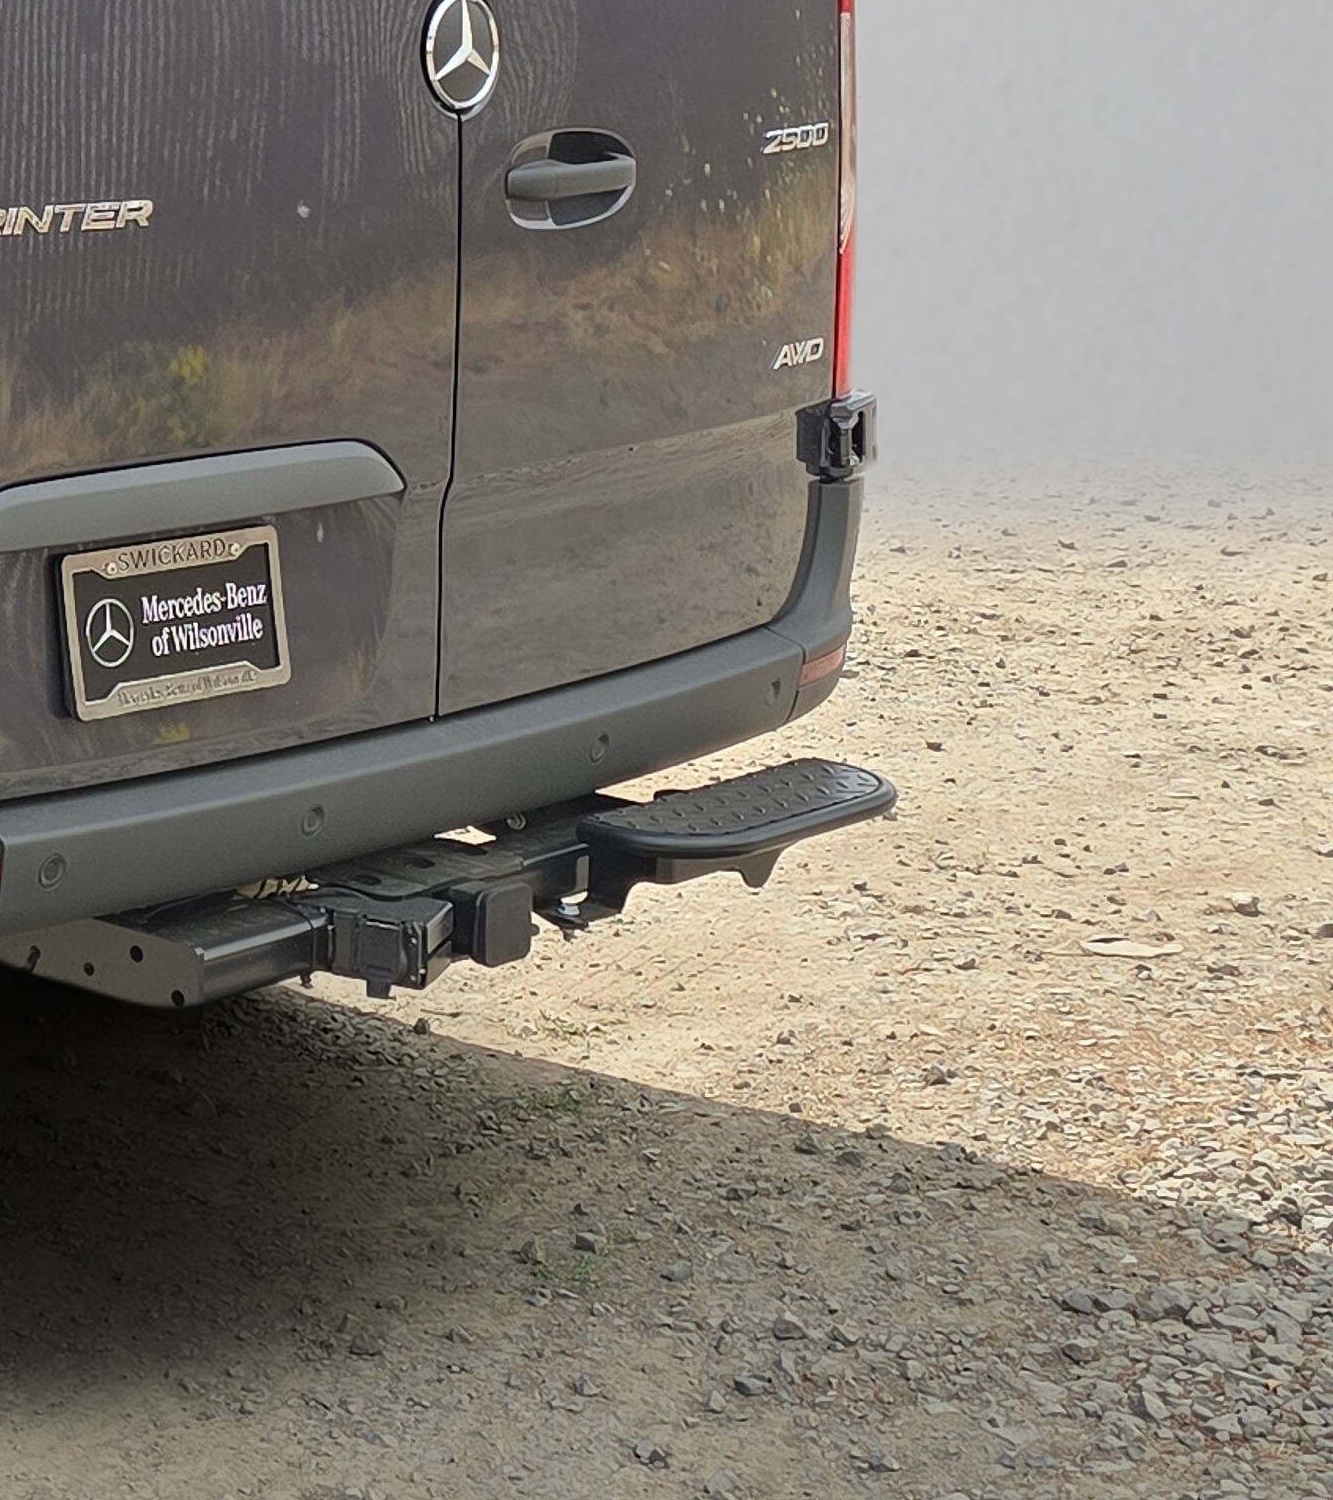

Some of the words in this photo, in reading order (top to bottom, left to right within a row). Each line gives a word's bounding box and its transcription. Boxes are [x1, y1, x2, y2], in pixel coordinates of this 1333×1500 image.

[762, 121, 829, 154] 2500
[772, 337, 824, 370] AWD
[117, 537, 227, 572] SWICKARD
[141, 583, 267, 624] Mercedes-Benz
[151, 628, 171, 657] of
[171, 612, 263, 652] Wilsonville
